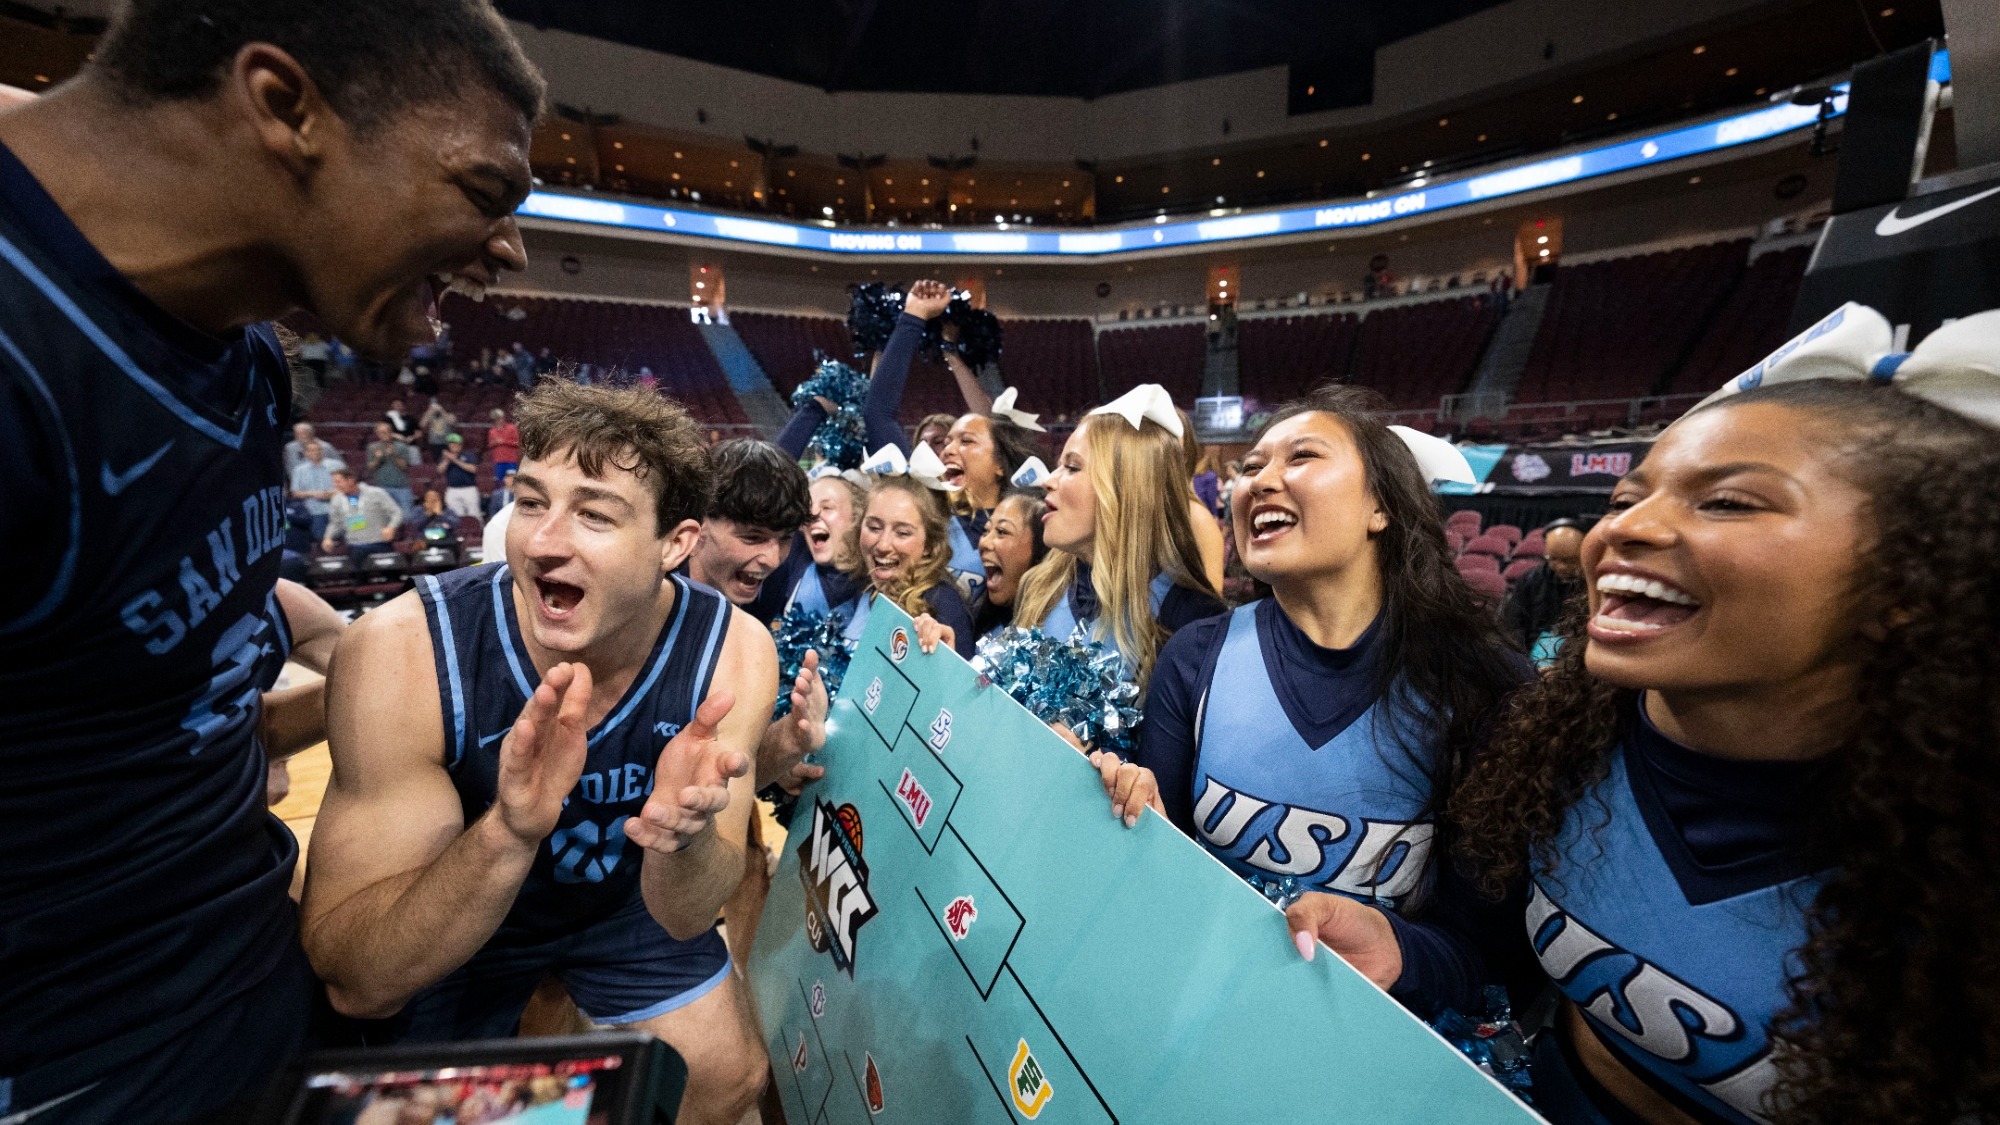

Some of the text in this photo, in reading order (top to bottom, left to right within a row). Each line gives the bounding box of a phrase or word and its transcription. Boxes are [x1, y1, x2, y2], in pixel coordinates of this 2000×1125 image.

[1315, 193, 1426, 226] MOVING ON
[829, 233, 922, 250] MOVING ON
[1569, 453, 1632, 477] LMU
[120, 486, 286, 655] SAN DIE
[581, 762, 654, 803] DIE
[897, 769, 932, 827] LMU
[1193, 774, 1436, 898] USD
[810, 804, 872, 964] WCC
